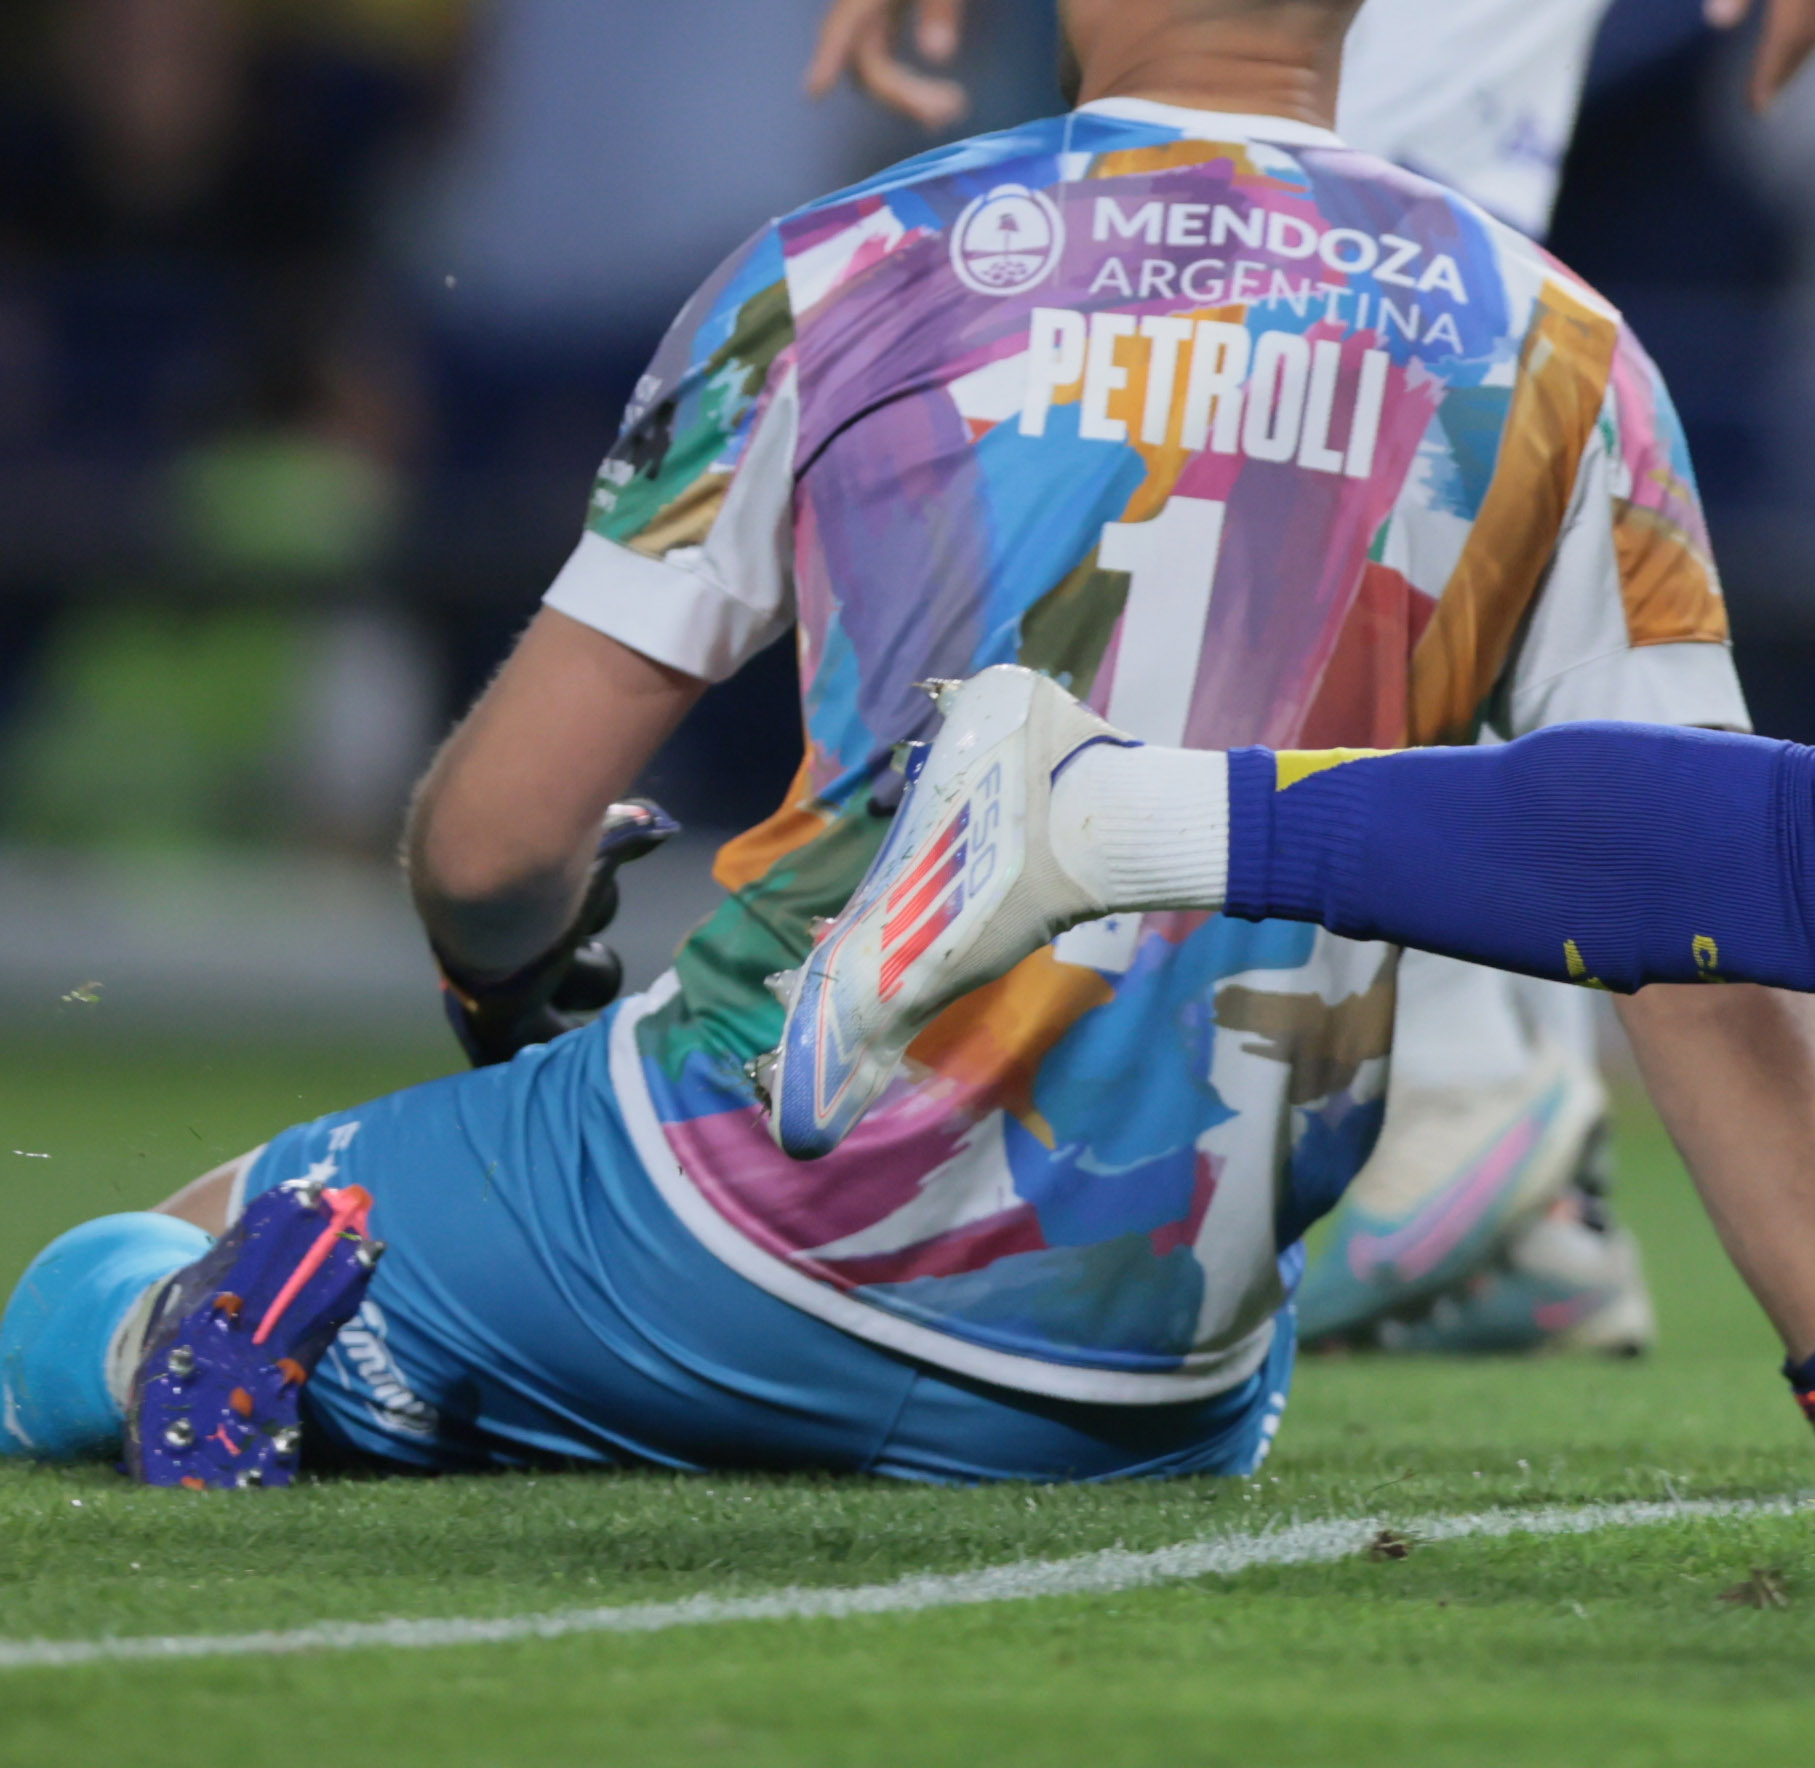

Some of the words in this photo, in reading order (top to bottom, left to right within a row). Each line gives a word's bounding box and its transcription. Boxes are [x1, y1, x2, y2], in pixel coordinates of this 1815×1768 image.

[1088, 256, 1464, 355] ARGENTINA
[1091, 196, 1470, 304] MENDOZA
[1018, 306, 1390, 480] PETROLI
[969, 760, 1002, 899] F50
